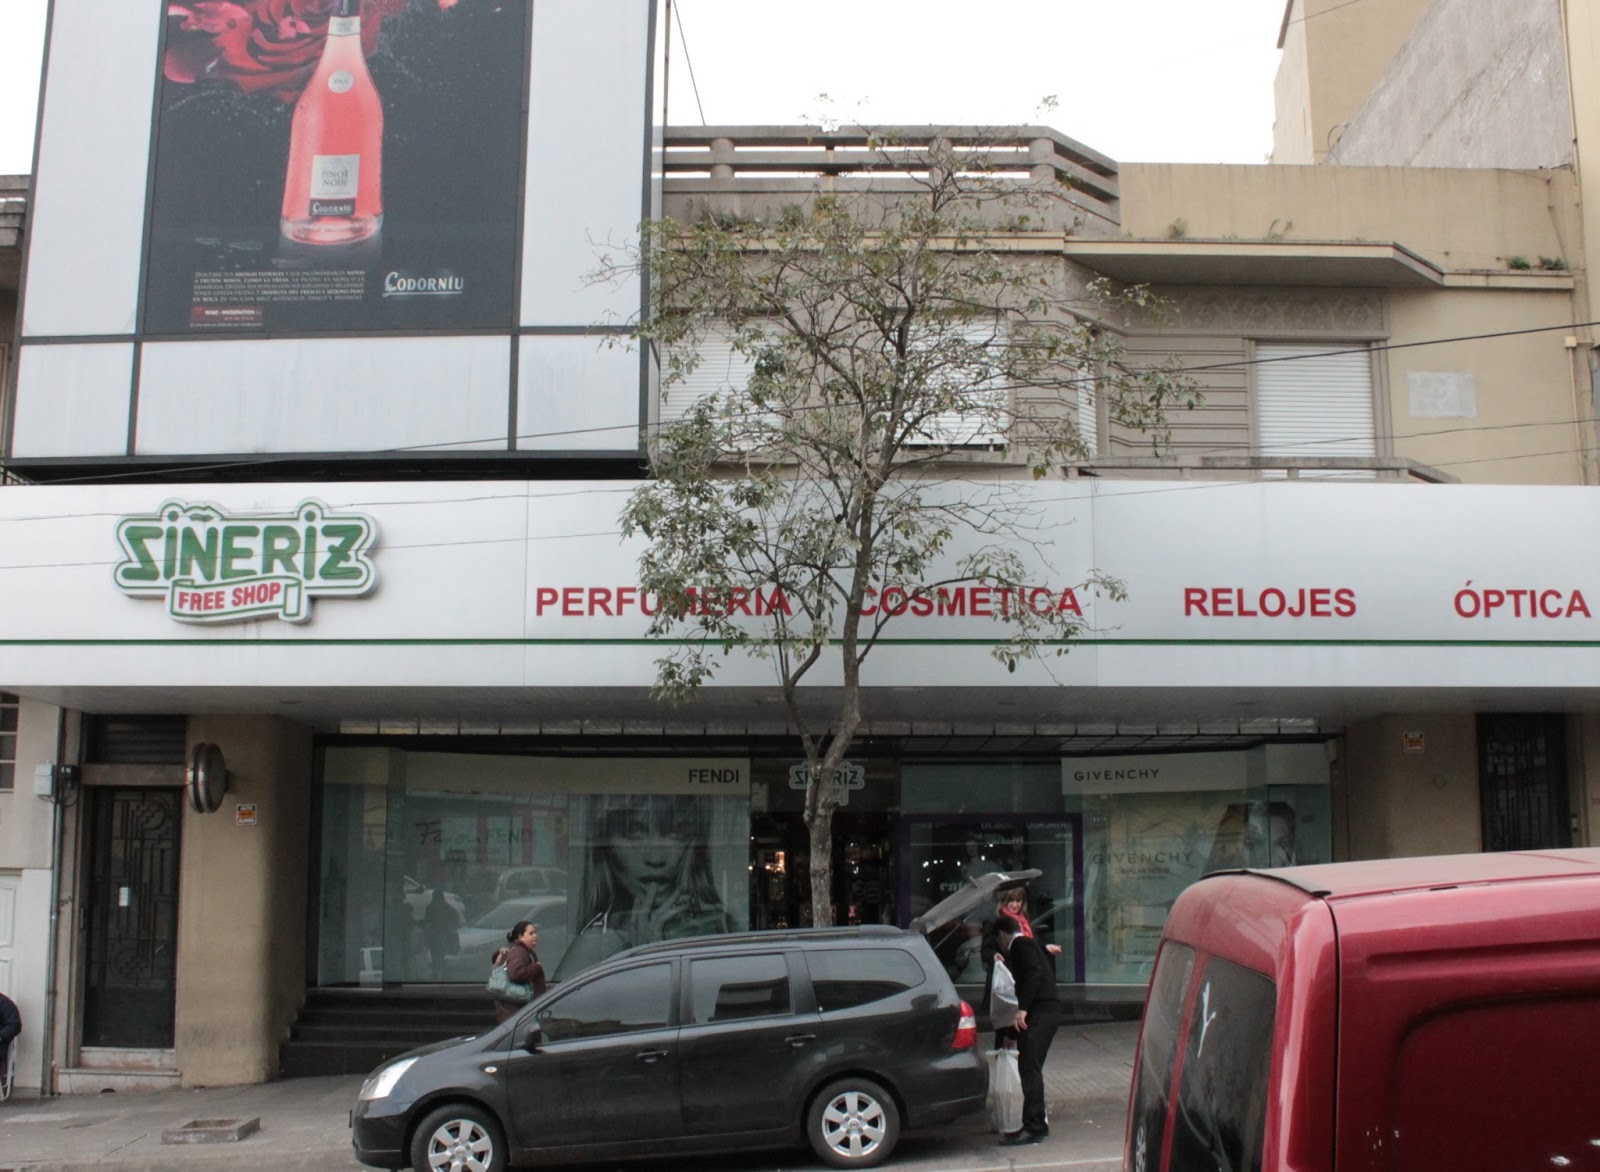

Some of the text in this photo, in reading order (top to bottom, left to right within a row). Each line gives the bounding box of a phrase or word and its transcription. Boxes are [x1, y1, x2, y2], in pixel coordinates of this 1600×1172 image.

[383, 271, 464, 292] CODORNÍU
[178, 582, 281, 611] FREE SHOP
[1184, 587, 1357, 618] RELOJES
[1453, 580, 1592, 618] ÓPTICA
[688, 769, 740, 784] FENDI
[1074, 768, 1160, 781] GIVENCHY
[1092, 850, 1193, 865] GIVENCHY
